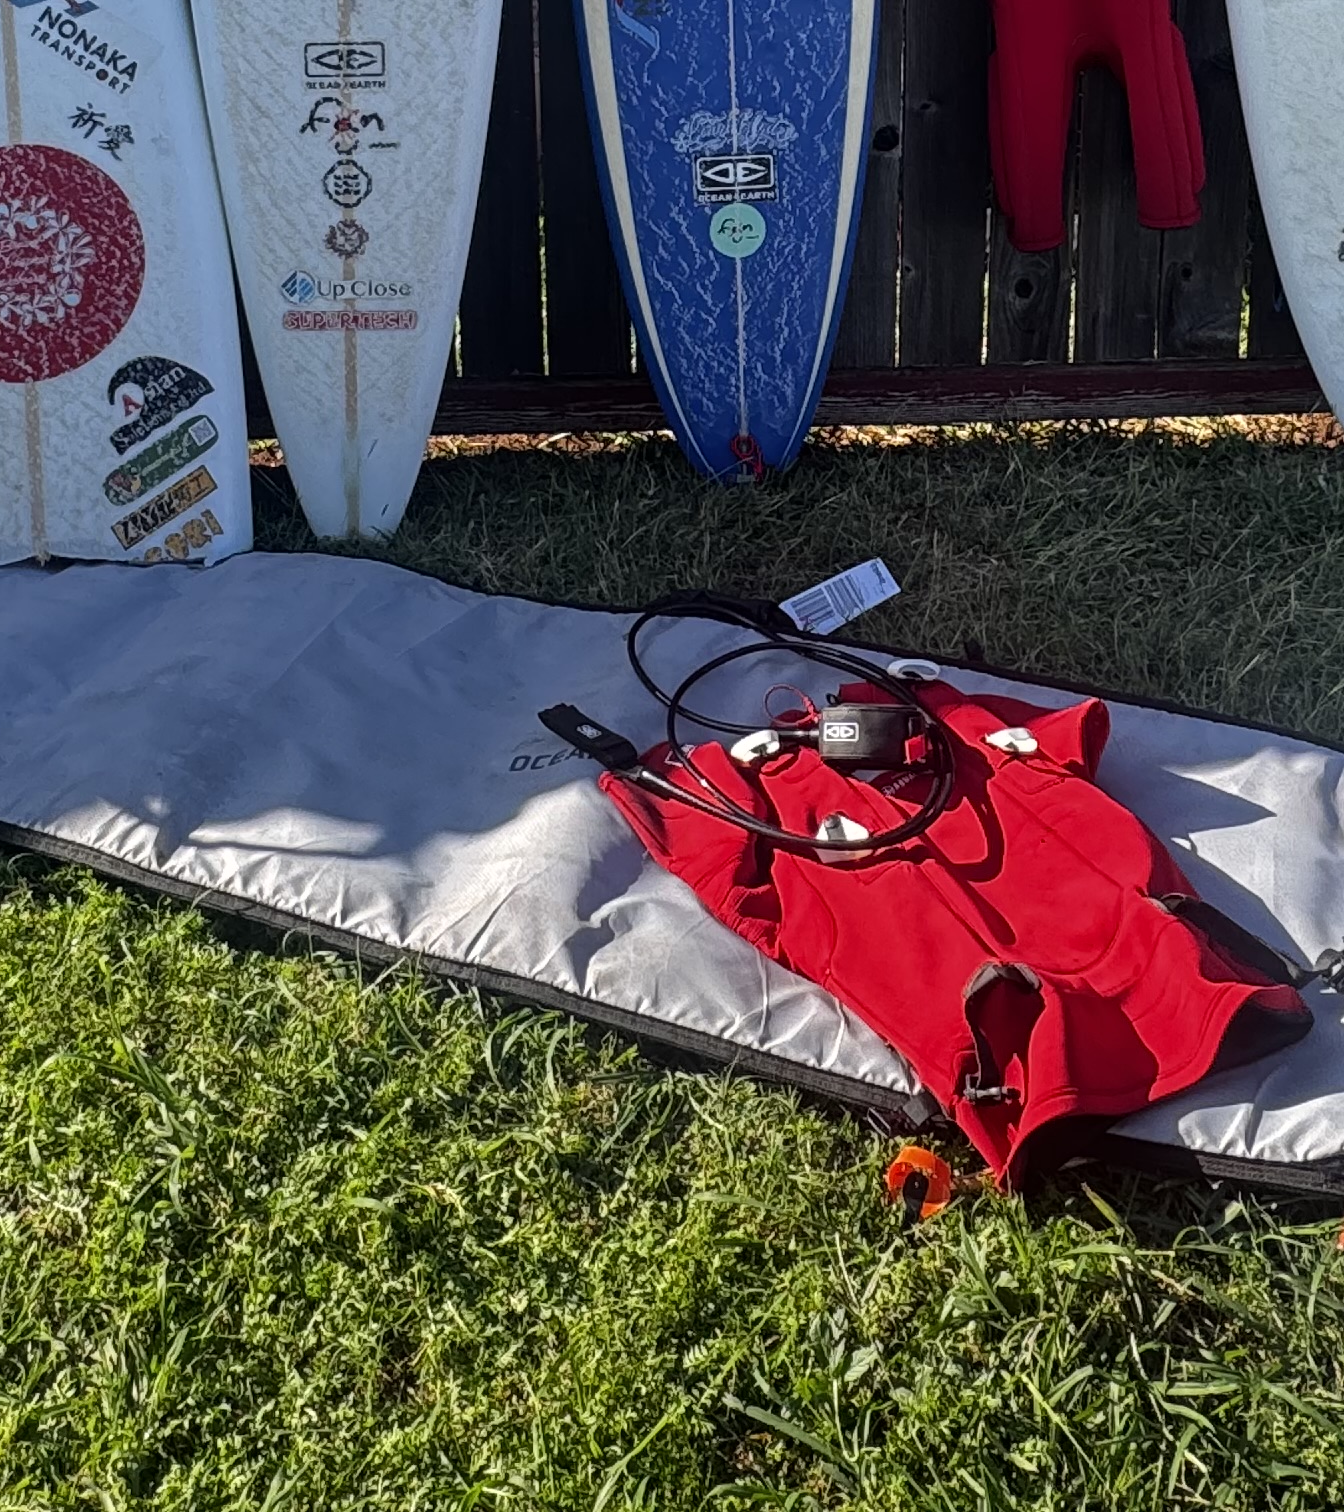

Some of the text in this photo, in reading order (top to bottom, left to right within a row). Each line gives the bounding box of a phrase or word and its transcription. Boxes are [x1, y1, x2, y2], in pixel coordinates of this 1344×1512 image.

[29, 23, 131, 94] TRANSPORT
[39, 5, 138, 82] NONAKA
[317, 280, 413, 300] Up Close
